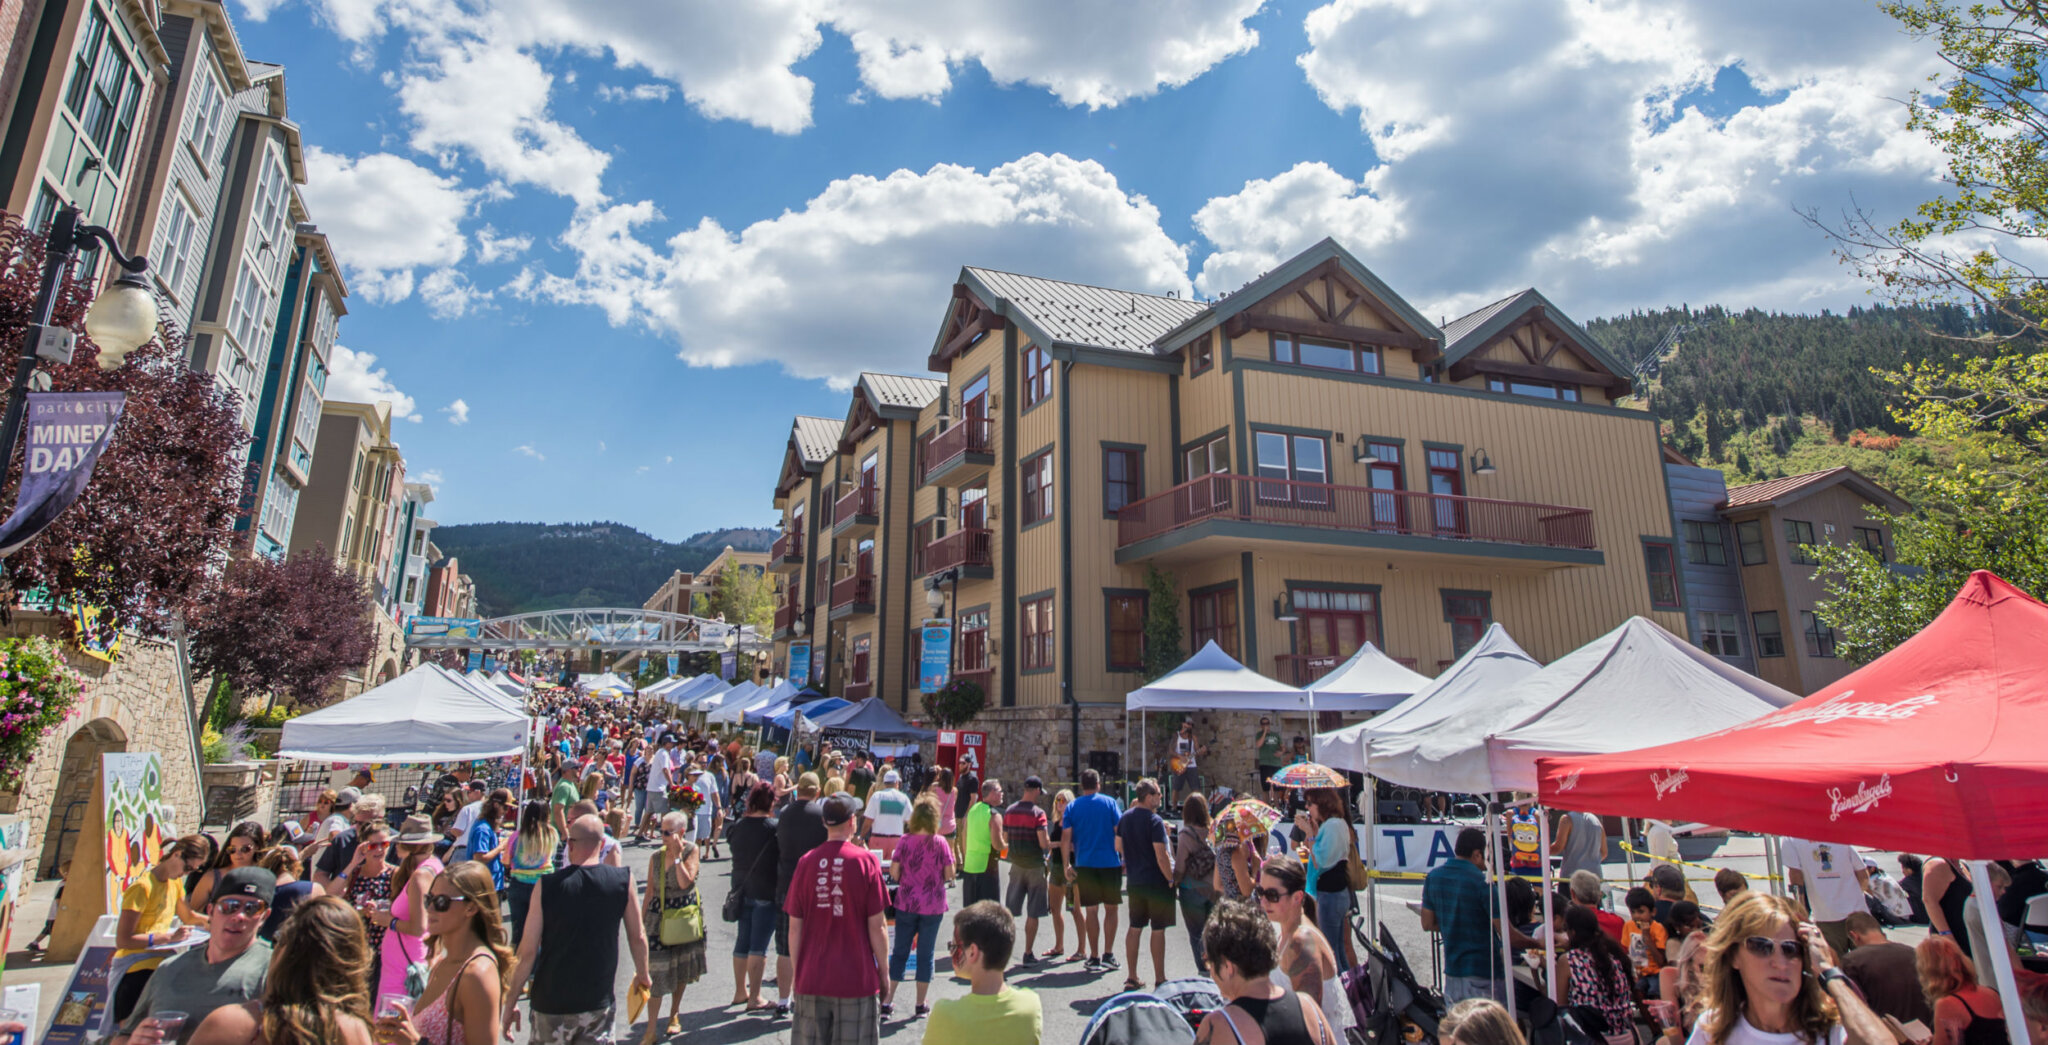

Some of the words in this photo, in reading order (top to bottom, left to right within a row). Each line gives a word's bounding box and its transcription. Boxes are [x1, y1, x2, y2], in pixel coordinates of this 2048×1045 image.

[37, 401, 72, 416] park
[87, 400, 119, 416] city
[821, 736, 868, 749] LESSONS
[964, 735, 982, 744] ATM
